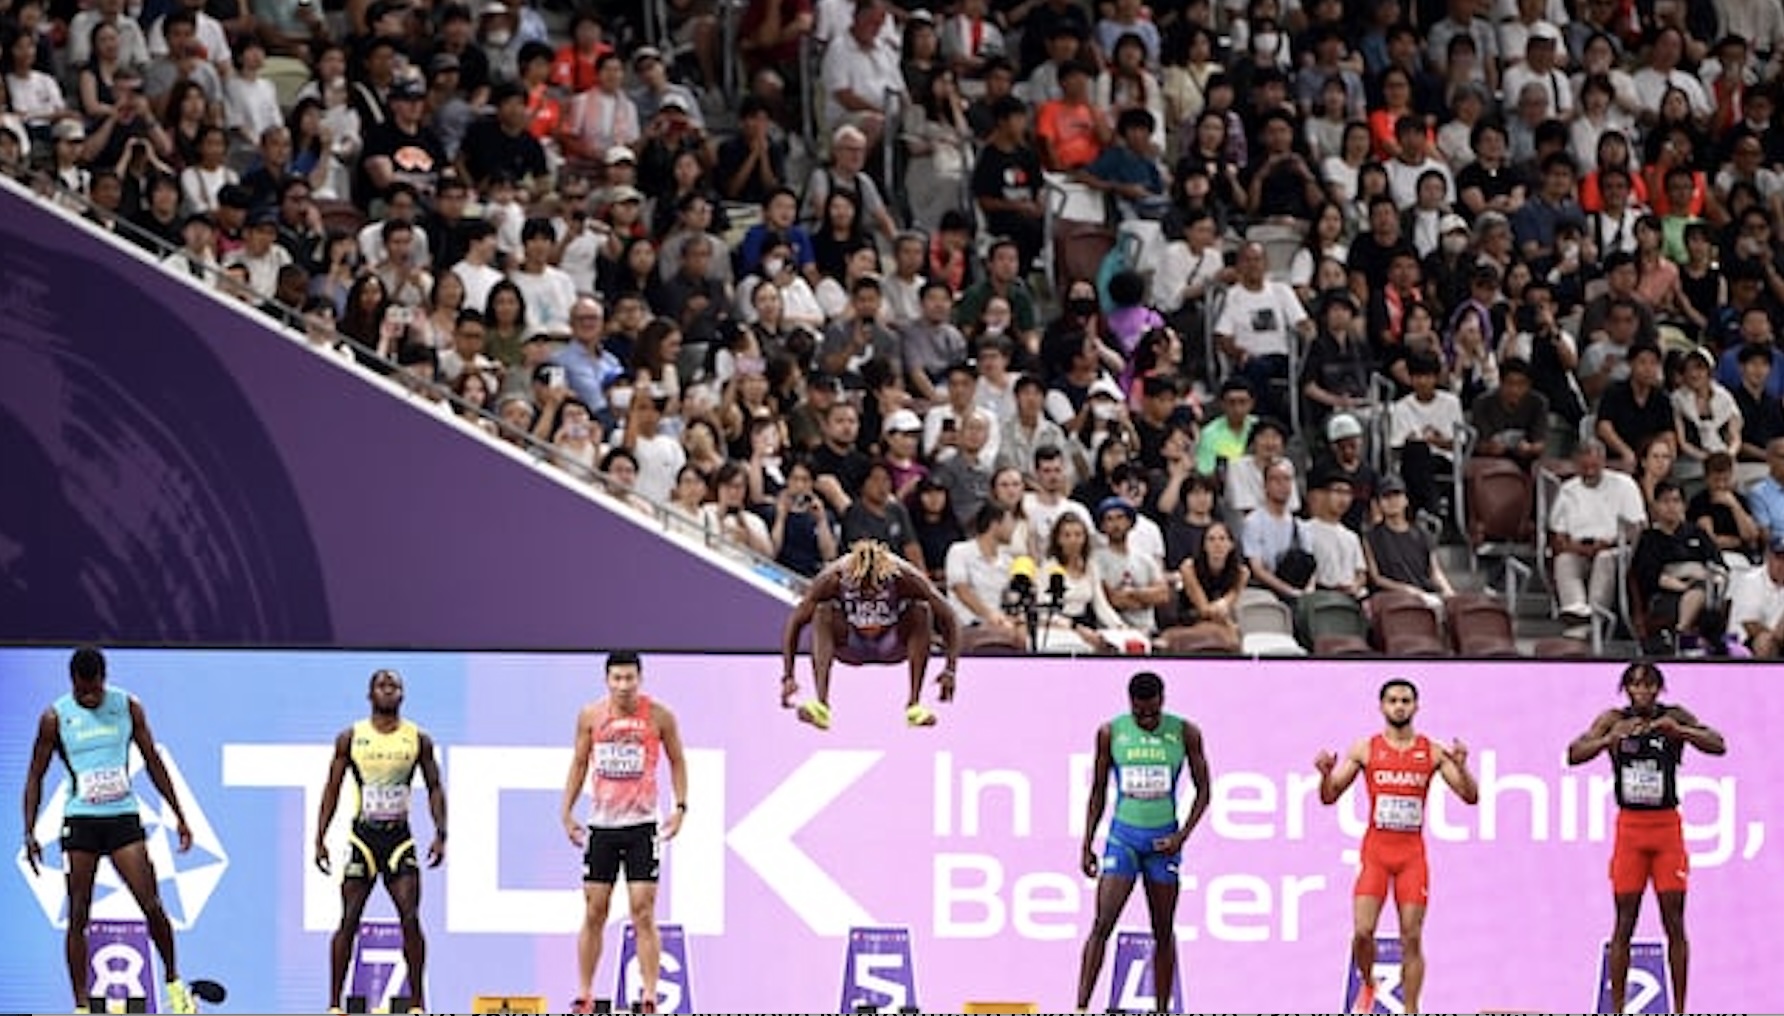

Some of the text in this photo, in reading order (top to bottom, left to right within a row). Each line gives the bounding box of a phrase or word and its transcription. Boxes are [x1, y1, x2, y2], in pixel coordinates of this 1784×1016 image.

[933, 751, 1031, 837] In
[223, 744, 887, 936] TDK
[933, 853, 1326, 942] Beer
[91, 942, 148, 998] 8
[361, 948, 407, 1013] 7
[625, 949, 682, 1013] 6
[851, 952, 907, 1013] 5
[1117, 959, 1175, 1010] 4
[1607, 966, 1661, 1013] 2
